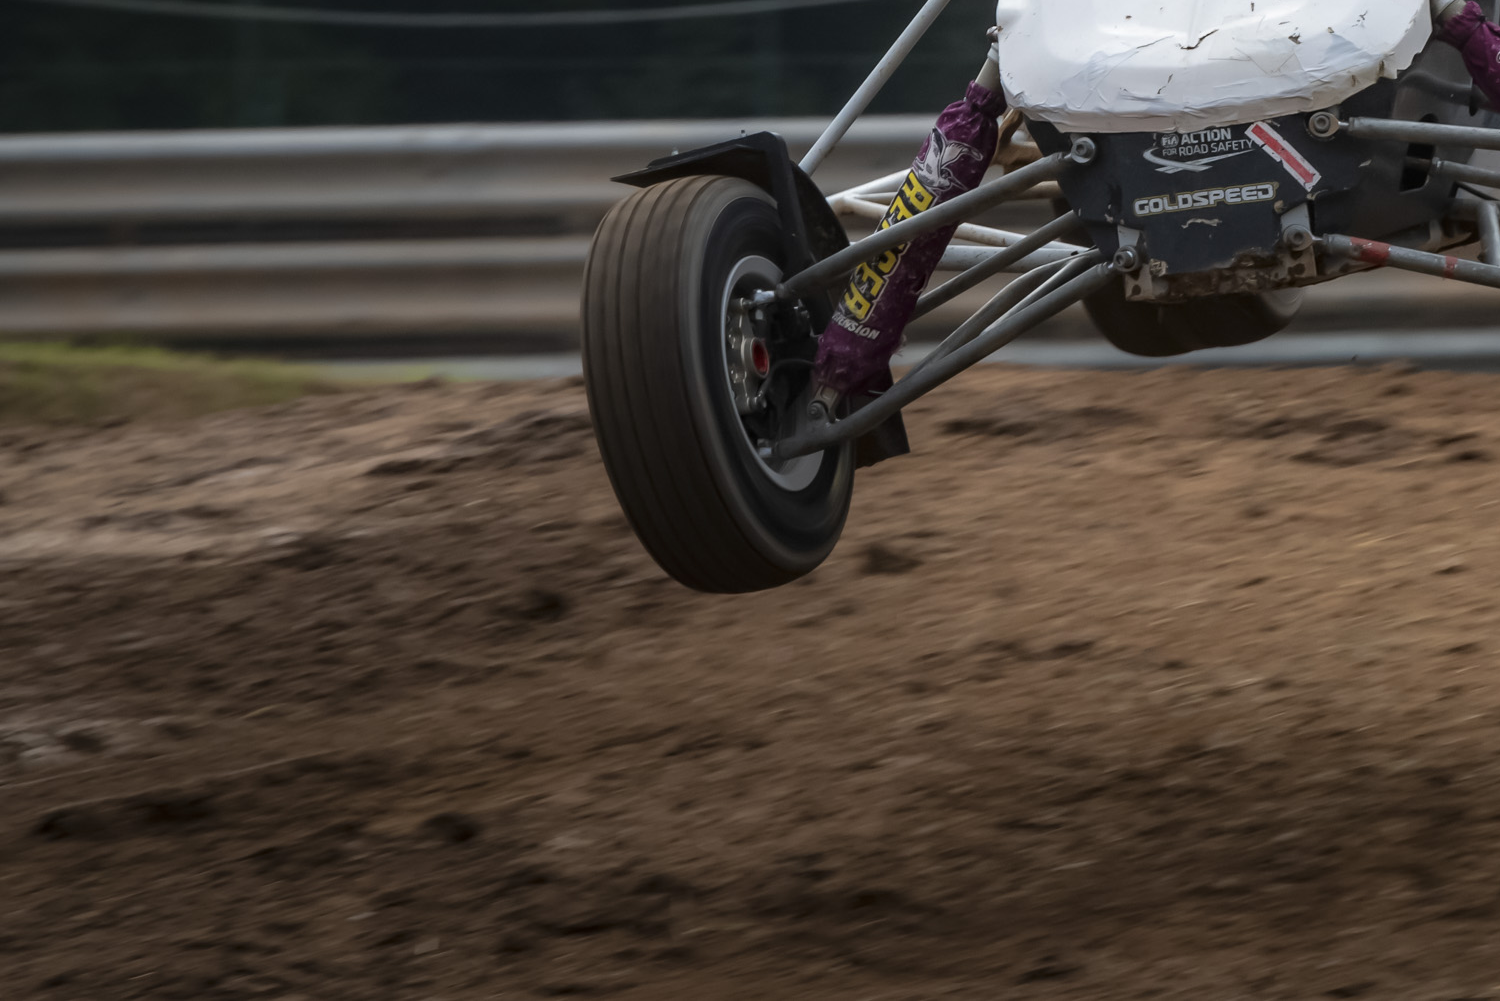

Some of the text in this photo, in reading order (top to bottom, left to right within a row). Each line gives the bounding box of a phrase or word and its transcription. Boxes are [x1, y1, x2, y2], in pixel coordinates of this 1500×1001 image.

[1180, 127, 1232, 145] ACTION
[1162, 138, 1255, 157] FOR ROAD SAFETY
[1134, 183, 1275, 216] GOLDSPEED
